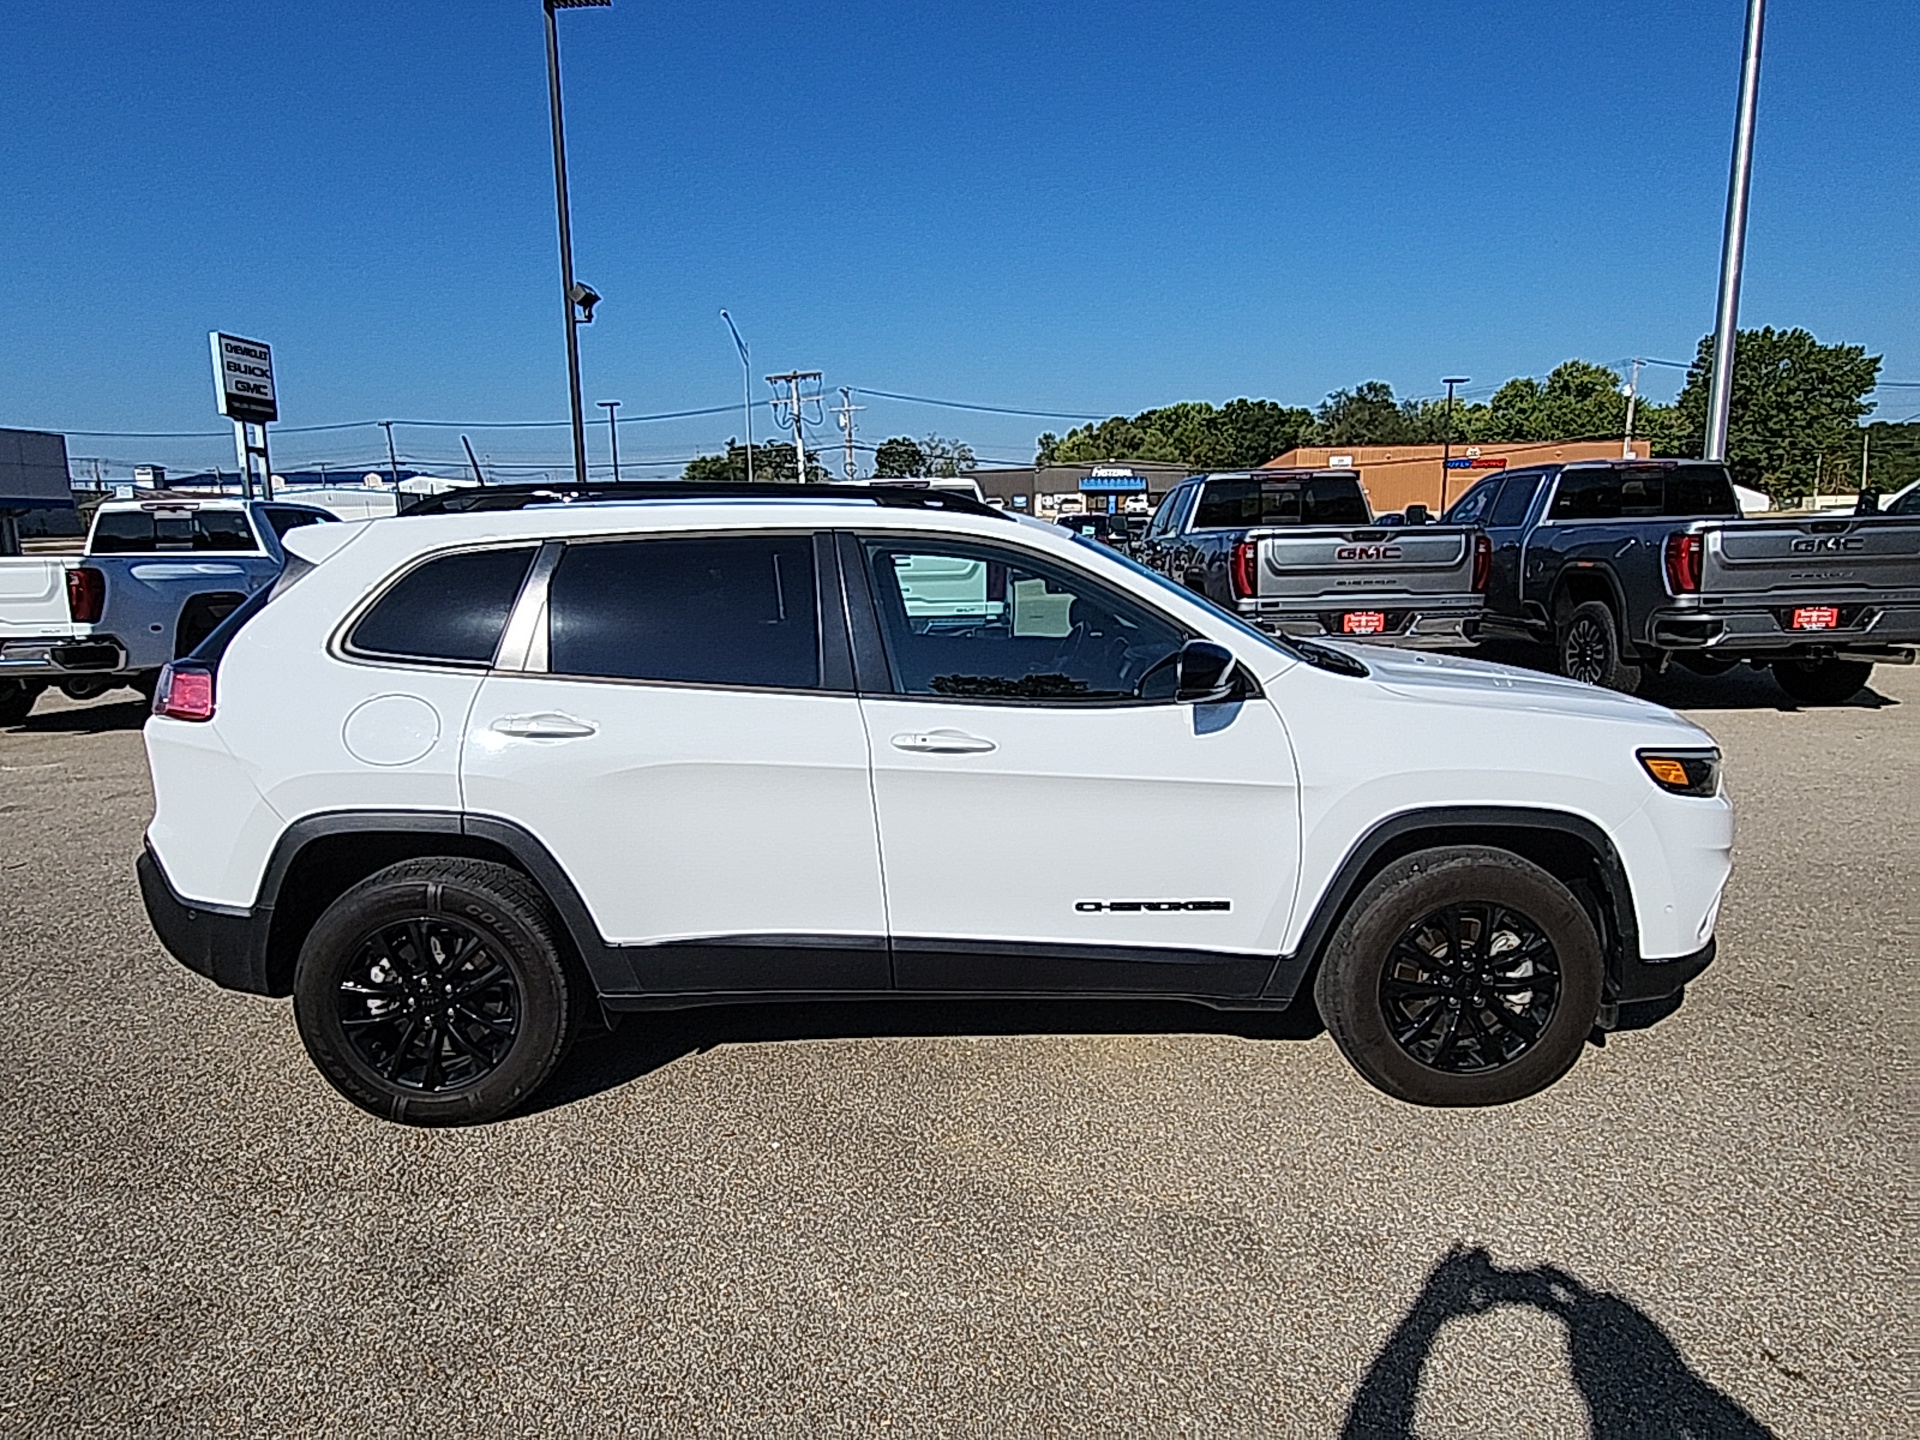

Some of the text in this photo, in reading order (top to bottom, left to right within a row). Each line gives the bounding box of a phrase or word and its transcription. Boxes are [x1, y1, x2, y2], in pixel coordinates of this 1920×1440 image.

[226, 361, 271, 379] BUICK
[234, 379, 268, 397] GMC
[1790, 537, 1863, 553] GMC
[1336, 546, 1402, 561] GMC
[1074, 901, 1231, 912] CHEROKEE
